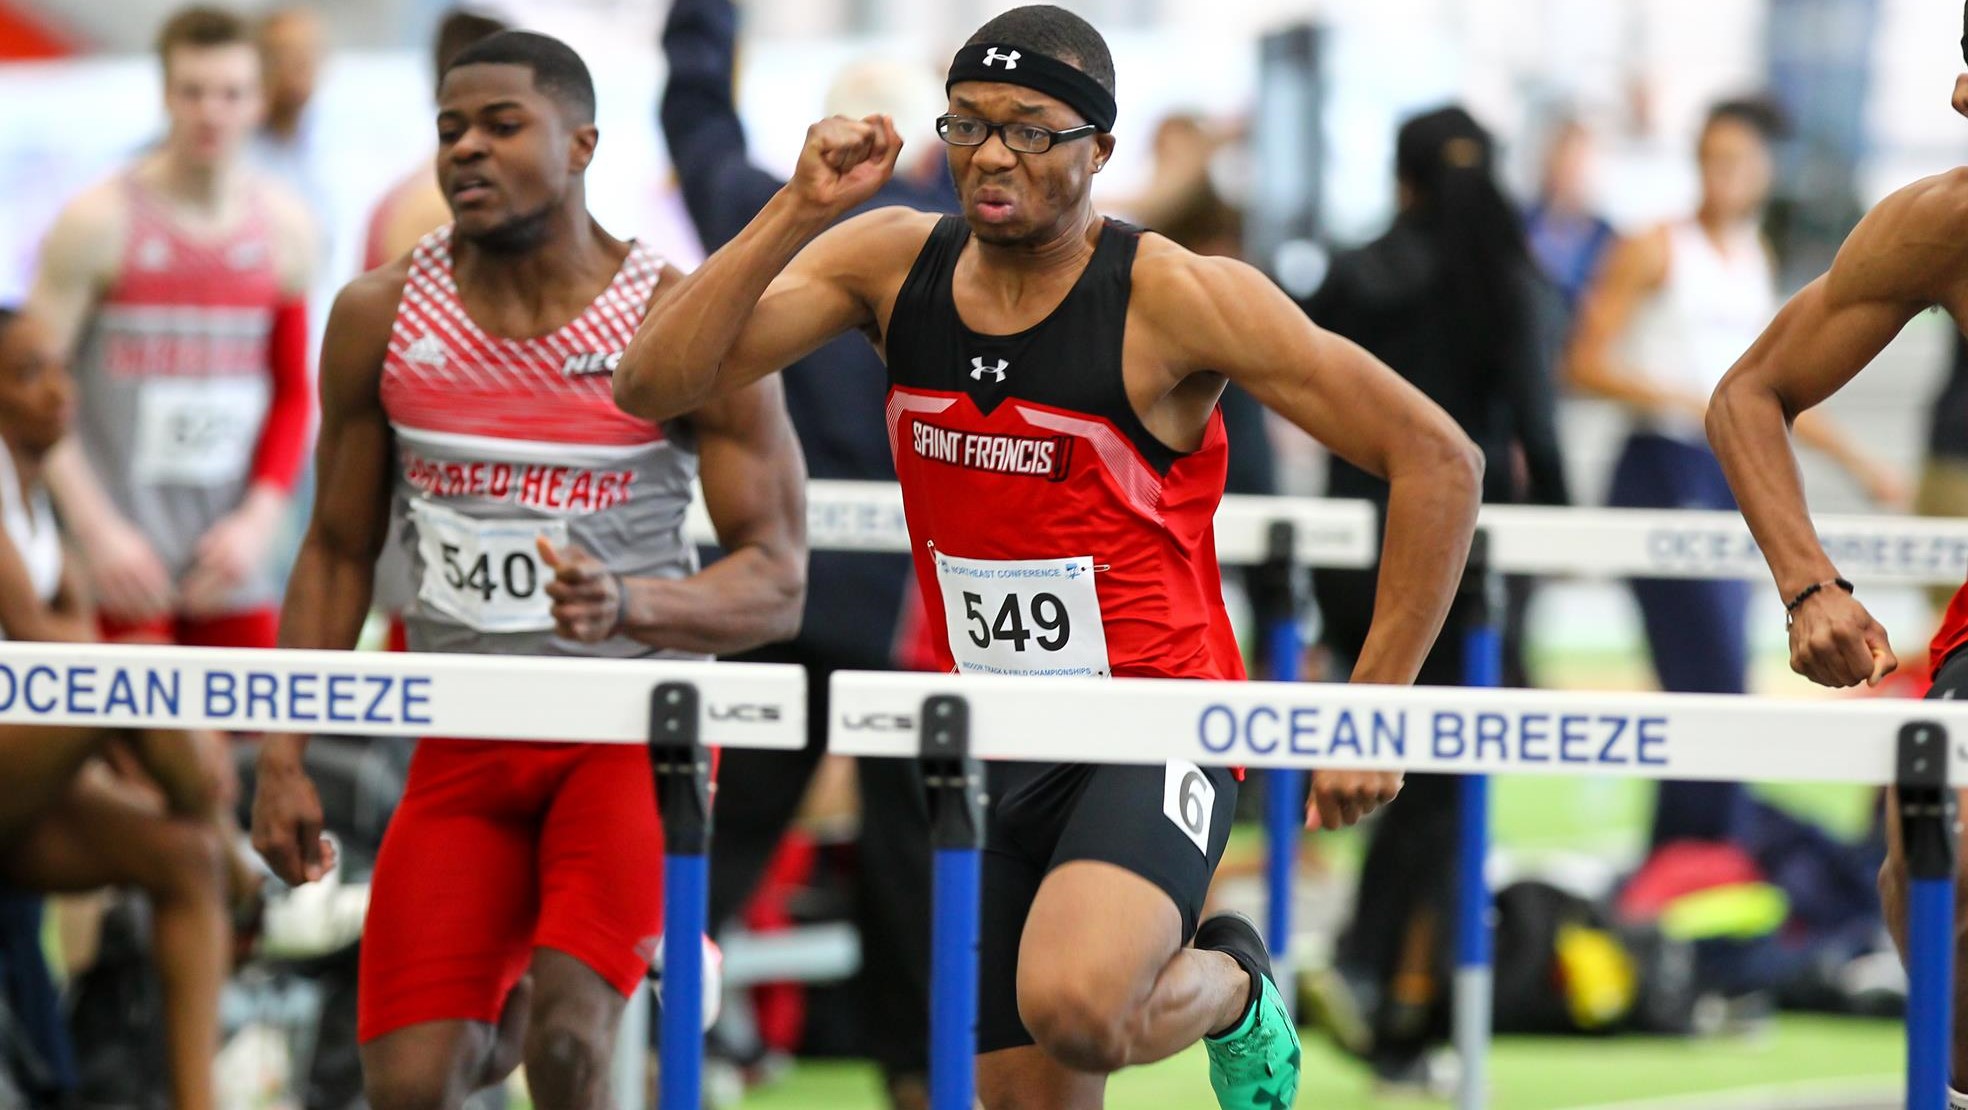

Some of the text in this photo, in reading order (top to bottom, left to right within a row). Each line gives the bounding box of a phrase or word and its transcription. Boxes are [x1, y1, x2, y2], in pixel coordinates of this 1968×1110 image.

[913, 421, 962, 463] SAINT
[964, 435, 1055, 474] FRANCIS
[441, 543, 537, 601] 540
[951, 566, 1062, 579] NORTHEAST CONFERENCE
[963, 591, 1070, 652] 549
[204, 671, 432, 724] BREEZE
[1029, 668, 1091, 677] CHAMPIONSHIPS
[708, 704, 781, 721] UCS
[842, 714, 914, 731] UCS
[1199, 704, 1669, 764] OCEAN BREEZE
[1179, 770, 1207, 834] 6
